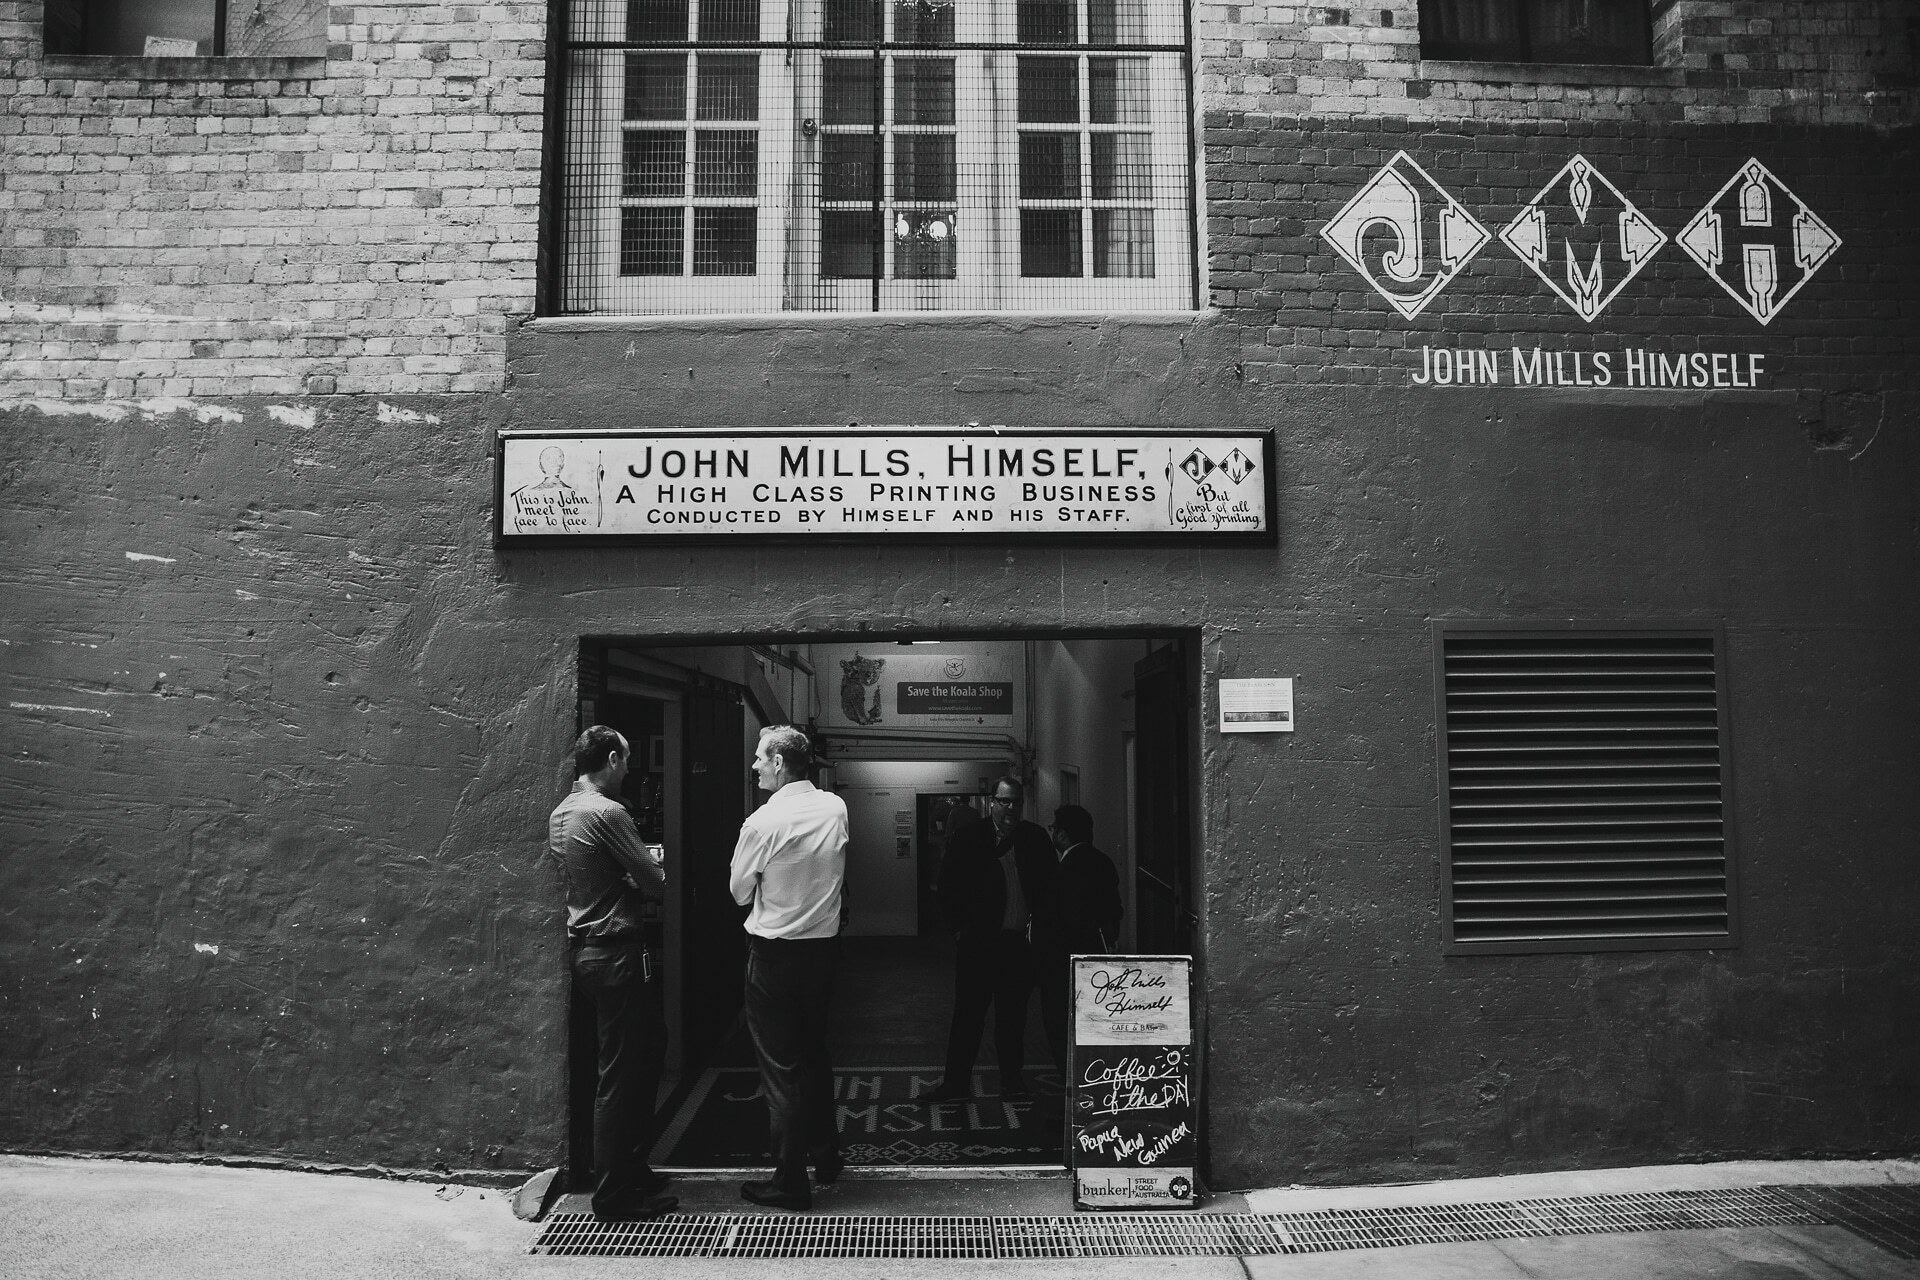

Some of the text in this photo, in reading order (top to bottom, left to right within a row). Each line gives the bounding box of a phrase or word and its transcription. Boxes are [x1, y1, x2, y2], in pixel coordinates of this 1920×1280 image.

[1411, 344, 1765, 388] JOHN MILLS HIMSELF
[627, 445, 1146, 480] JOHN MILLS, HIMSELF,
[510, 484, 593, 514] This is John.
[615, 483, 1156, 504] A HIGH CLASS PRINTING BUSINESS
[1196, 483, 1230, 502] But
[524, 505, 579, 516] meet me
[646, 507, 1130, 525] CONDUCTED BY HIMSELF AND HIS STAFF.
[1175, 507, 1207, 530] Good
[1216, 502, 1229, 516] of
[1232, 500, 1250, 513] all
[514, 516, 538, 534] face
[546, 516, 558, 526] to
[907, 685, 1003, 700] Save the Koala Shop
[1105, 991, 1173, 1018] Himself
[1084, 1057, 1175, 1091] Coffee
[1103, 1073, 1190, 1116] of the DAY
[1079, 1125, 1122, 1154] Papua
[1113, 1132, 1145, 1162] New
